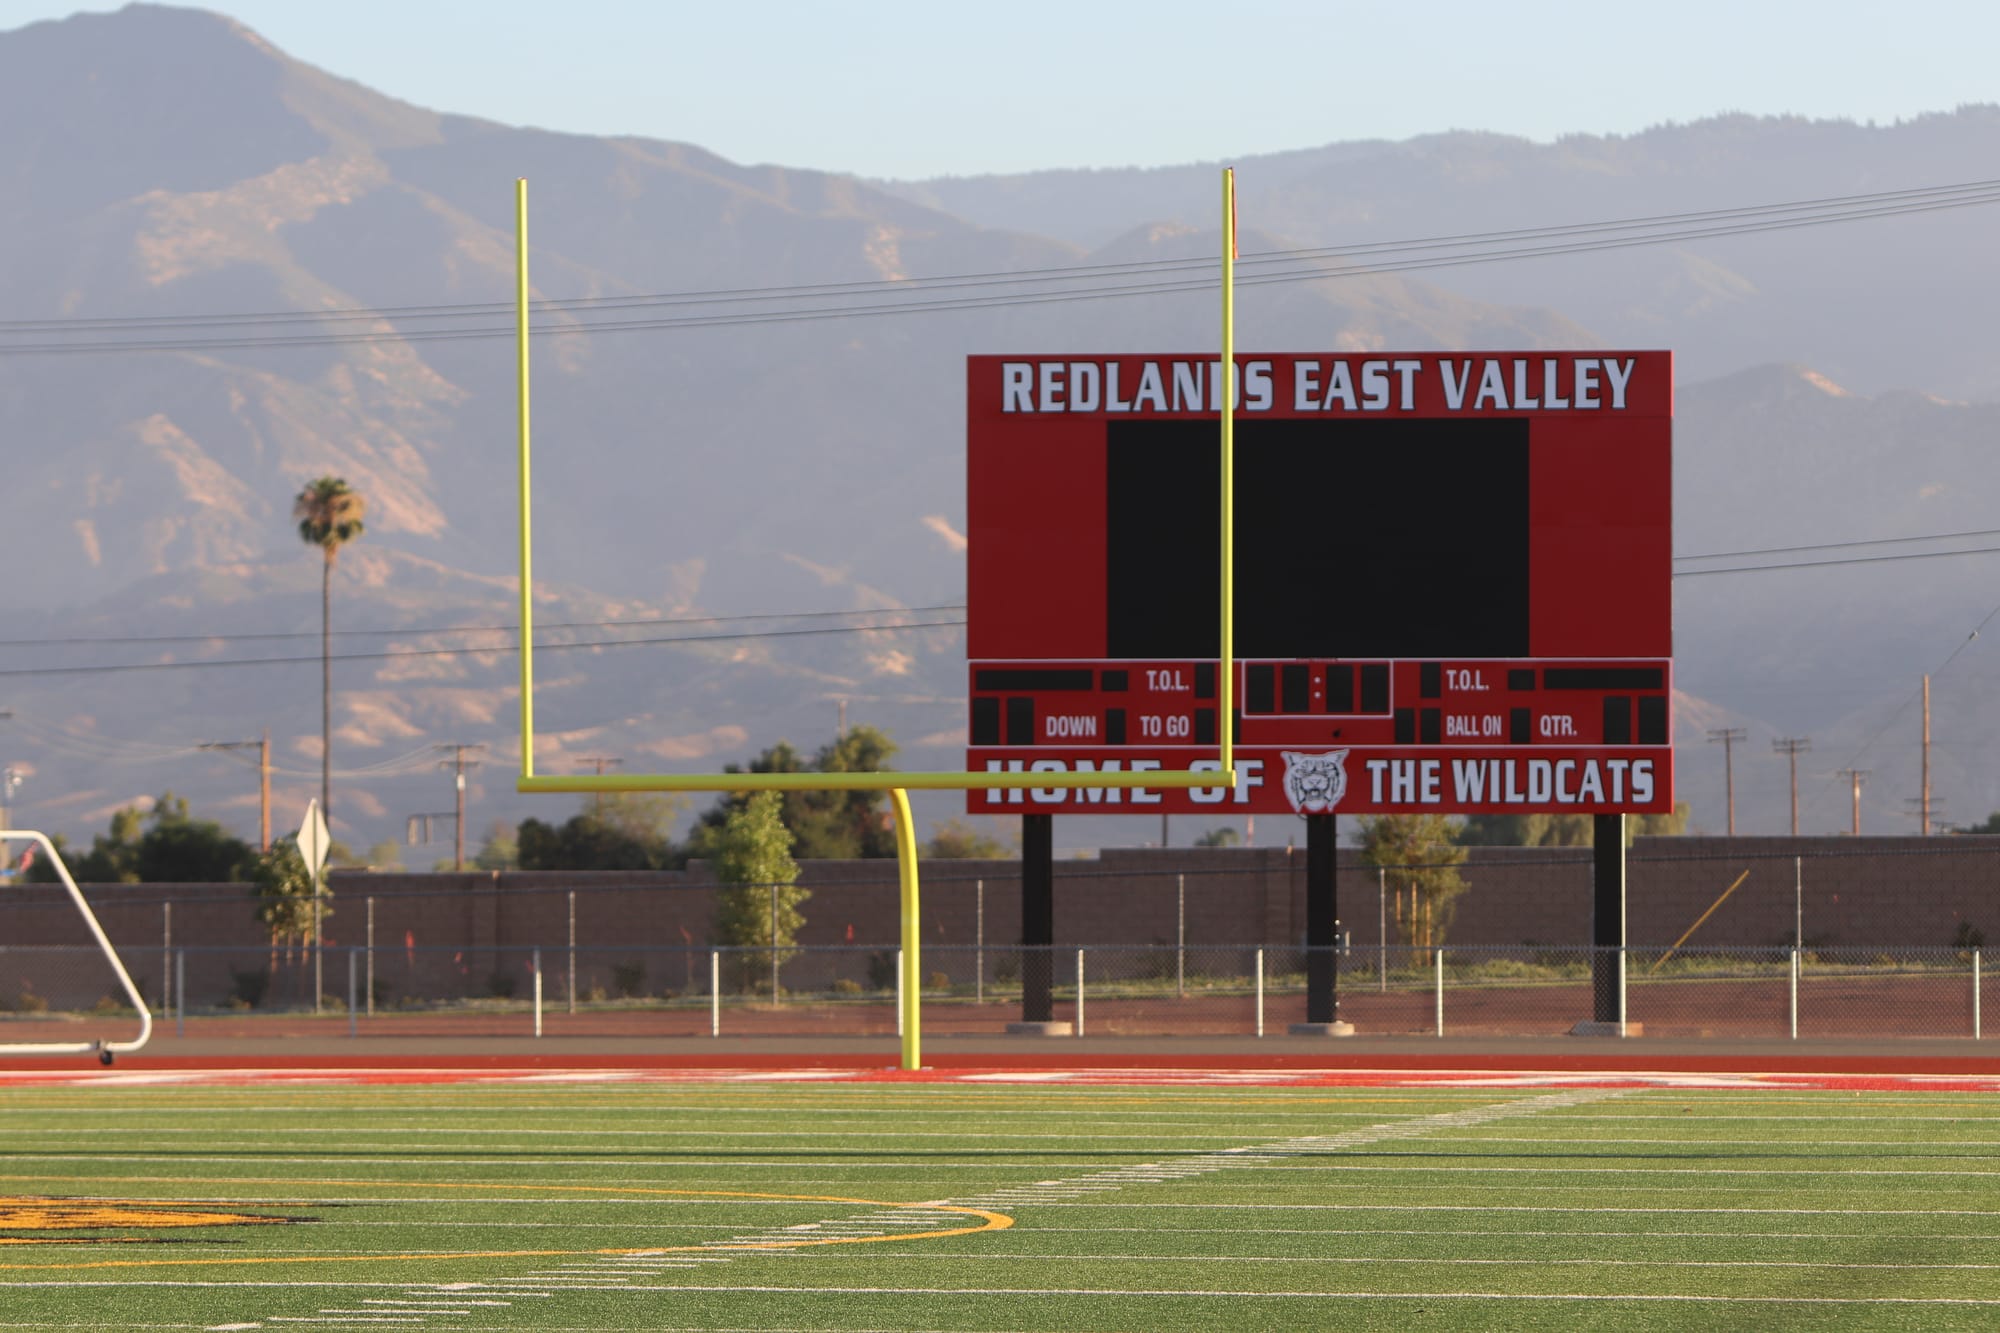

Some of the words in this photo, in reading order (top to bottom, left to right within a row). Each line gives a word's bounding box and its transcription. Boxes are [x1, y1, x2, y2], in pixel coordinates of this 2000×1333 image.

[1002, 361, 1273, 413] REDLANDS
[1293, 359, 1422, 411] EAST
[1438, 357, 1636, 410] VALLEY
[1146, 670, 1190, 691] T.O.L.
[1446, 669, 1490, 690] T.O.L.
[1046, 715, 1097, 737] DOWN
[1139, 715, 1162, 737] TO
[1166, 715, 1190, 737] GO
[1446, 715, 1480, 736] BALL
[1482, 715, 1502, 736] ON
[1539, 714, 1578, 736] QTR.
[984, 759, 1163, 804] HOME
[1187, 759, 1265, 804] OF
[1365, 759, 1442, 804] THE
[1451, 758, 1655, 804] WILDCATS
